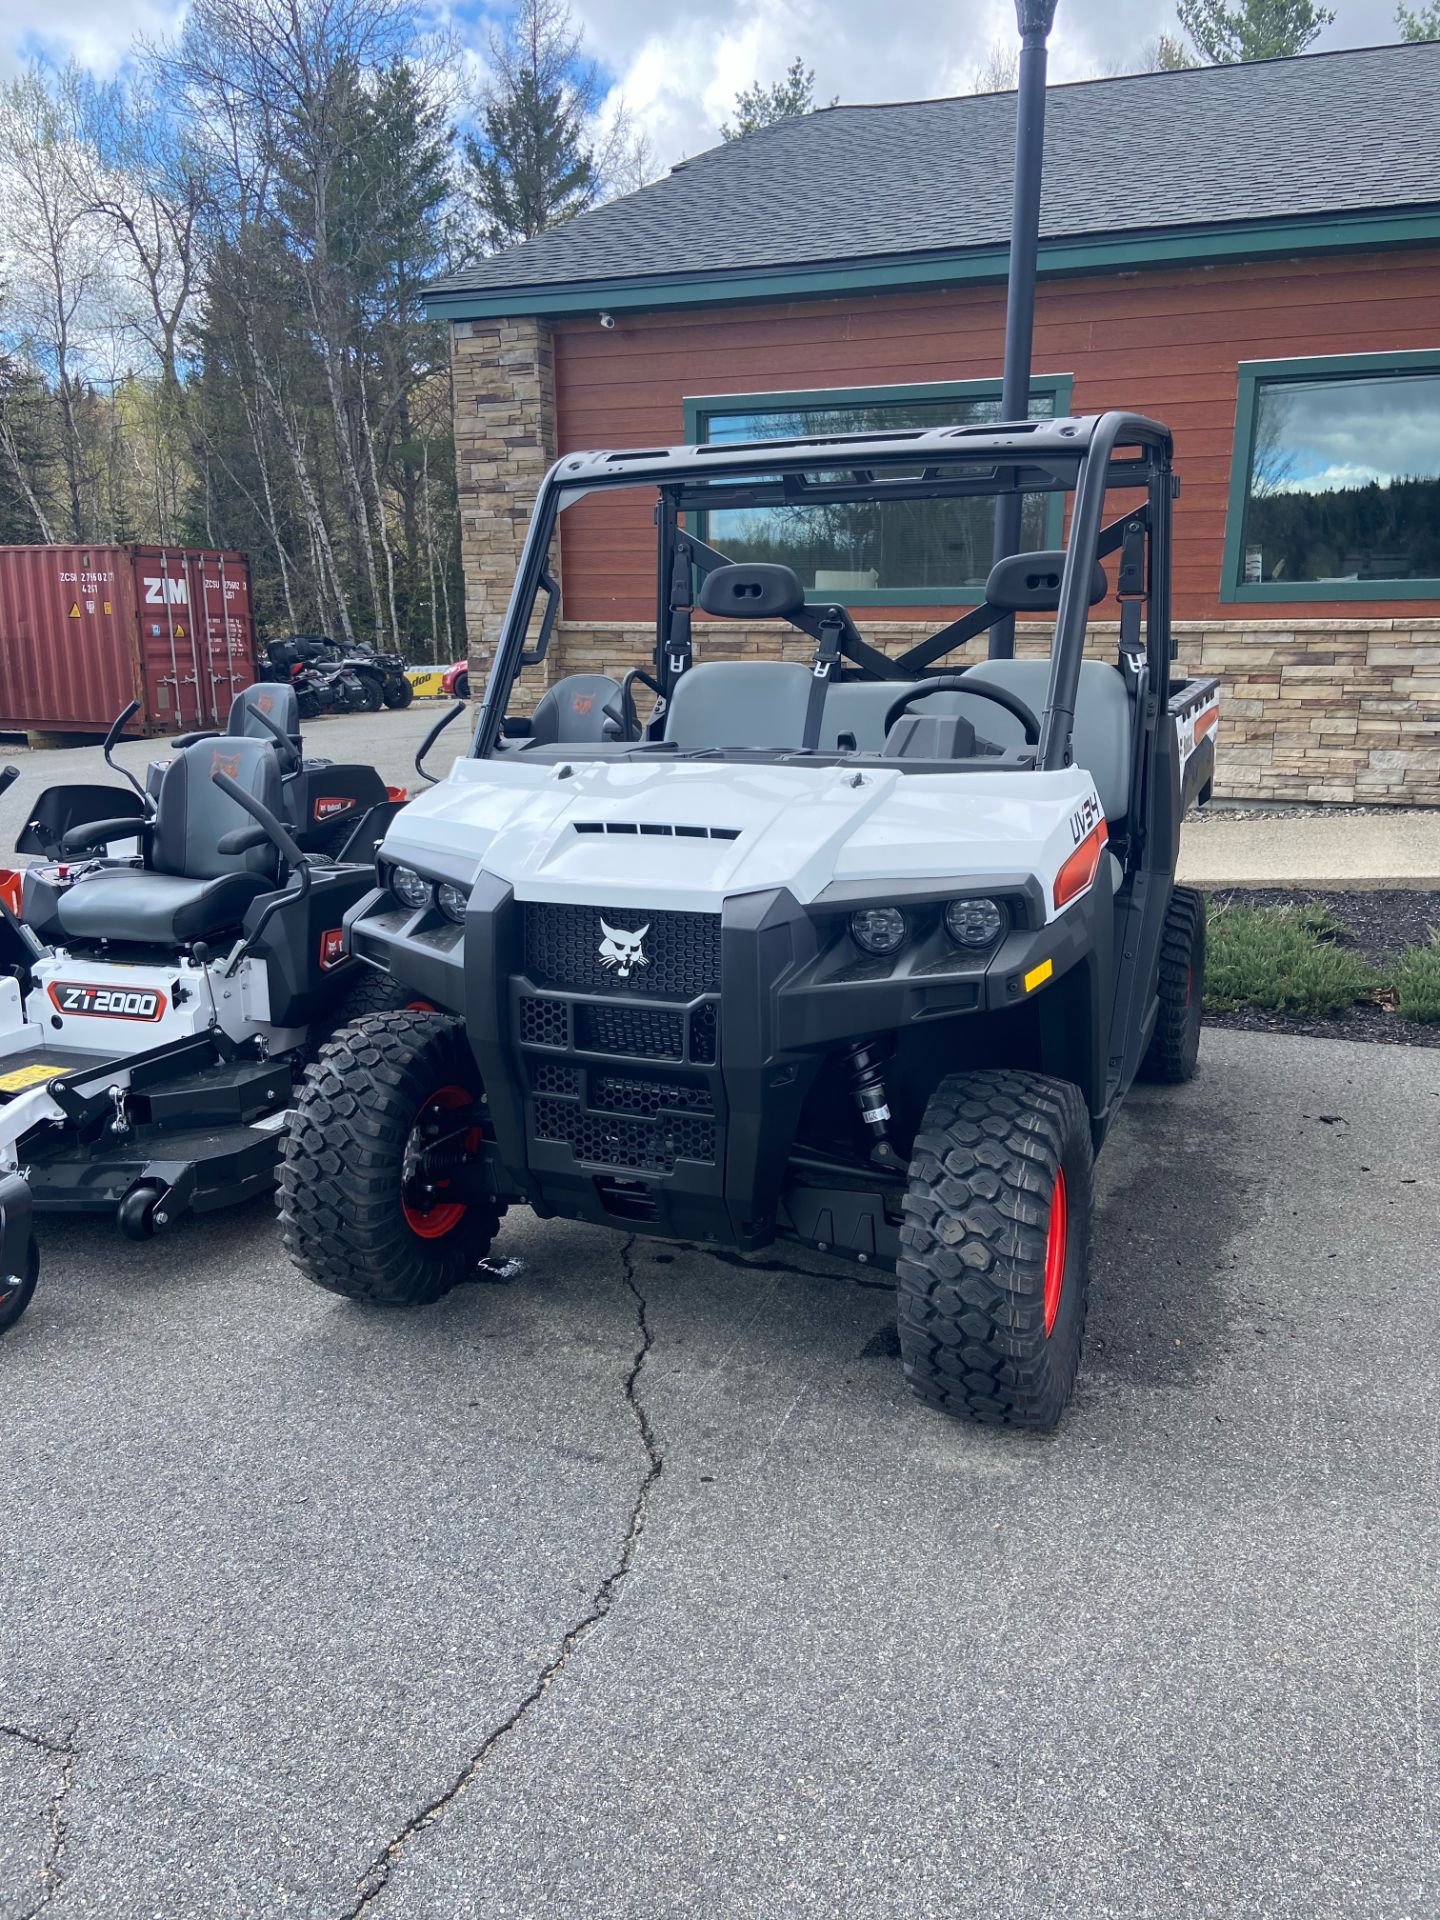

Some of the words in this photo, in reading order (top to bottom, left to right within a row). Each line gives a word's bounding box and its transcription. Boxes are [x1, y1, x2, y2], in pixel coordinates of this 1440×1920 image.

[143, 577, 188, 605] ZIM
[1069, 791, 1101, 846] UV34
[62, 988, 157, 1016] ZT2000
